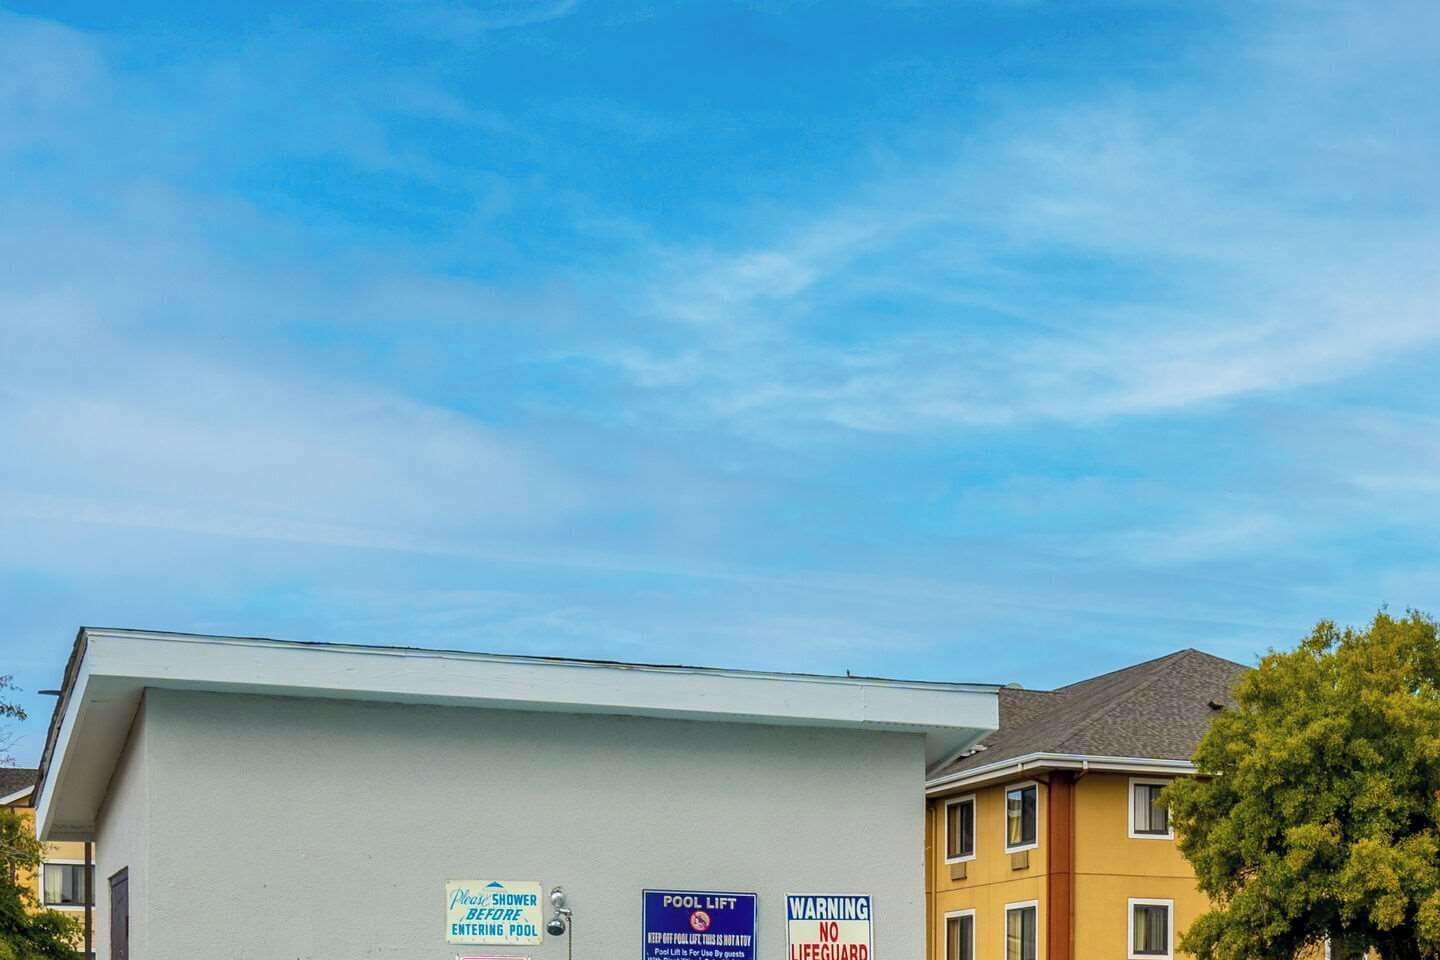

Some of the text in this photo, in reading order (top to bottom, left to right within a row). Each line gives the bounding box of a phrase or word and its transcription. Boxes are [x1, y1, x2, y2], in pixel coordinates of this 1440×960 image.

[450, 888, 537, 910] Please SHOWER
[663, 895, 737, 910] POOL LIFT
[466, 908, 523, 921] BEFORE
[789, 897, 868, 920] WARNING
[451, 923, 538, 937] ENTERING POOL
[819, 921, 839, 943] NO
[648, 932, 661, 944] KEEP
[674, 932, 689, 945] POOL
[717, 934, 723, 946] IS
[724, 934, 735, 947] NOT
[736, 935, 741, 947] A
[741, 935, 752, 947] TOY
[655, 947, 669, 956] Pool
[670, 948, 680, 956] Lift
[689, 949, 700, 957] For
[700, 949, 713, 957] Use
[715, 949, 723, 959] By
